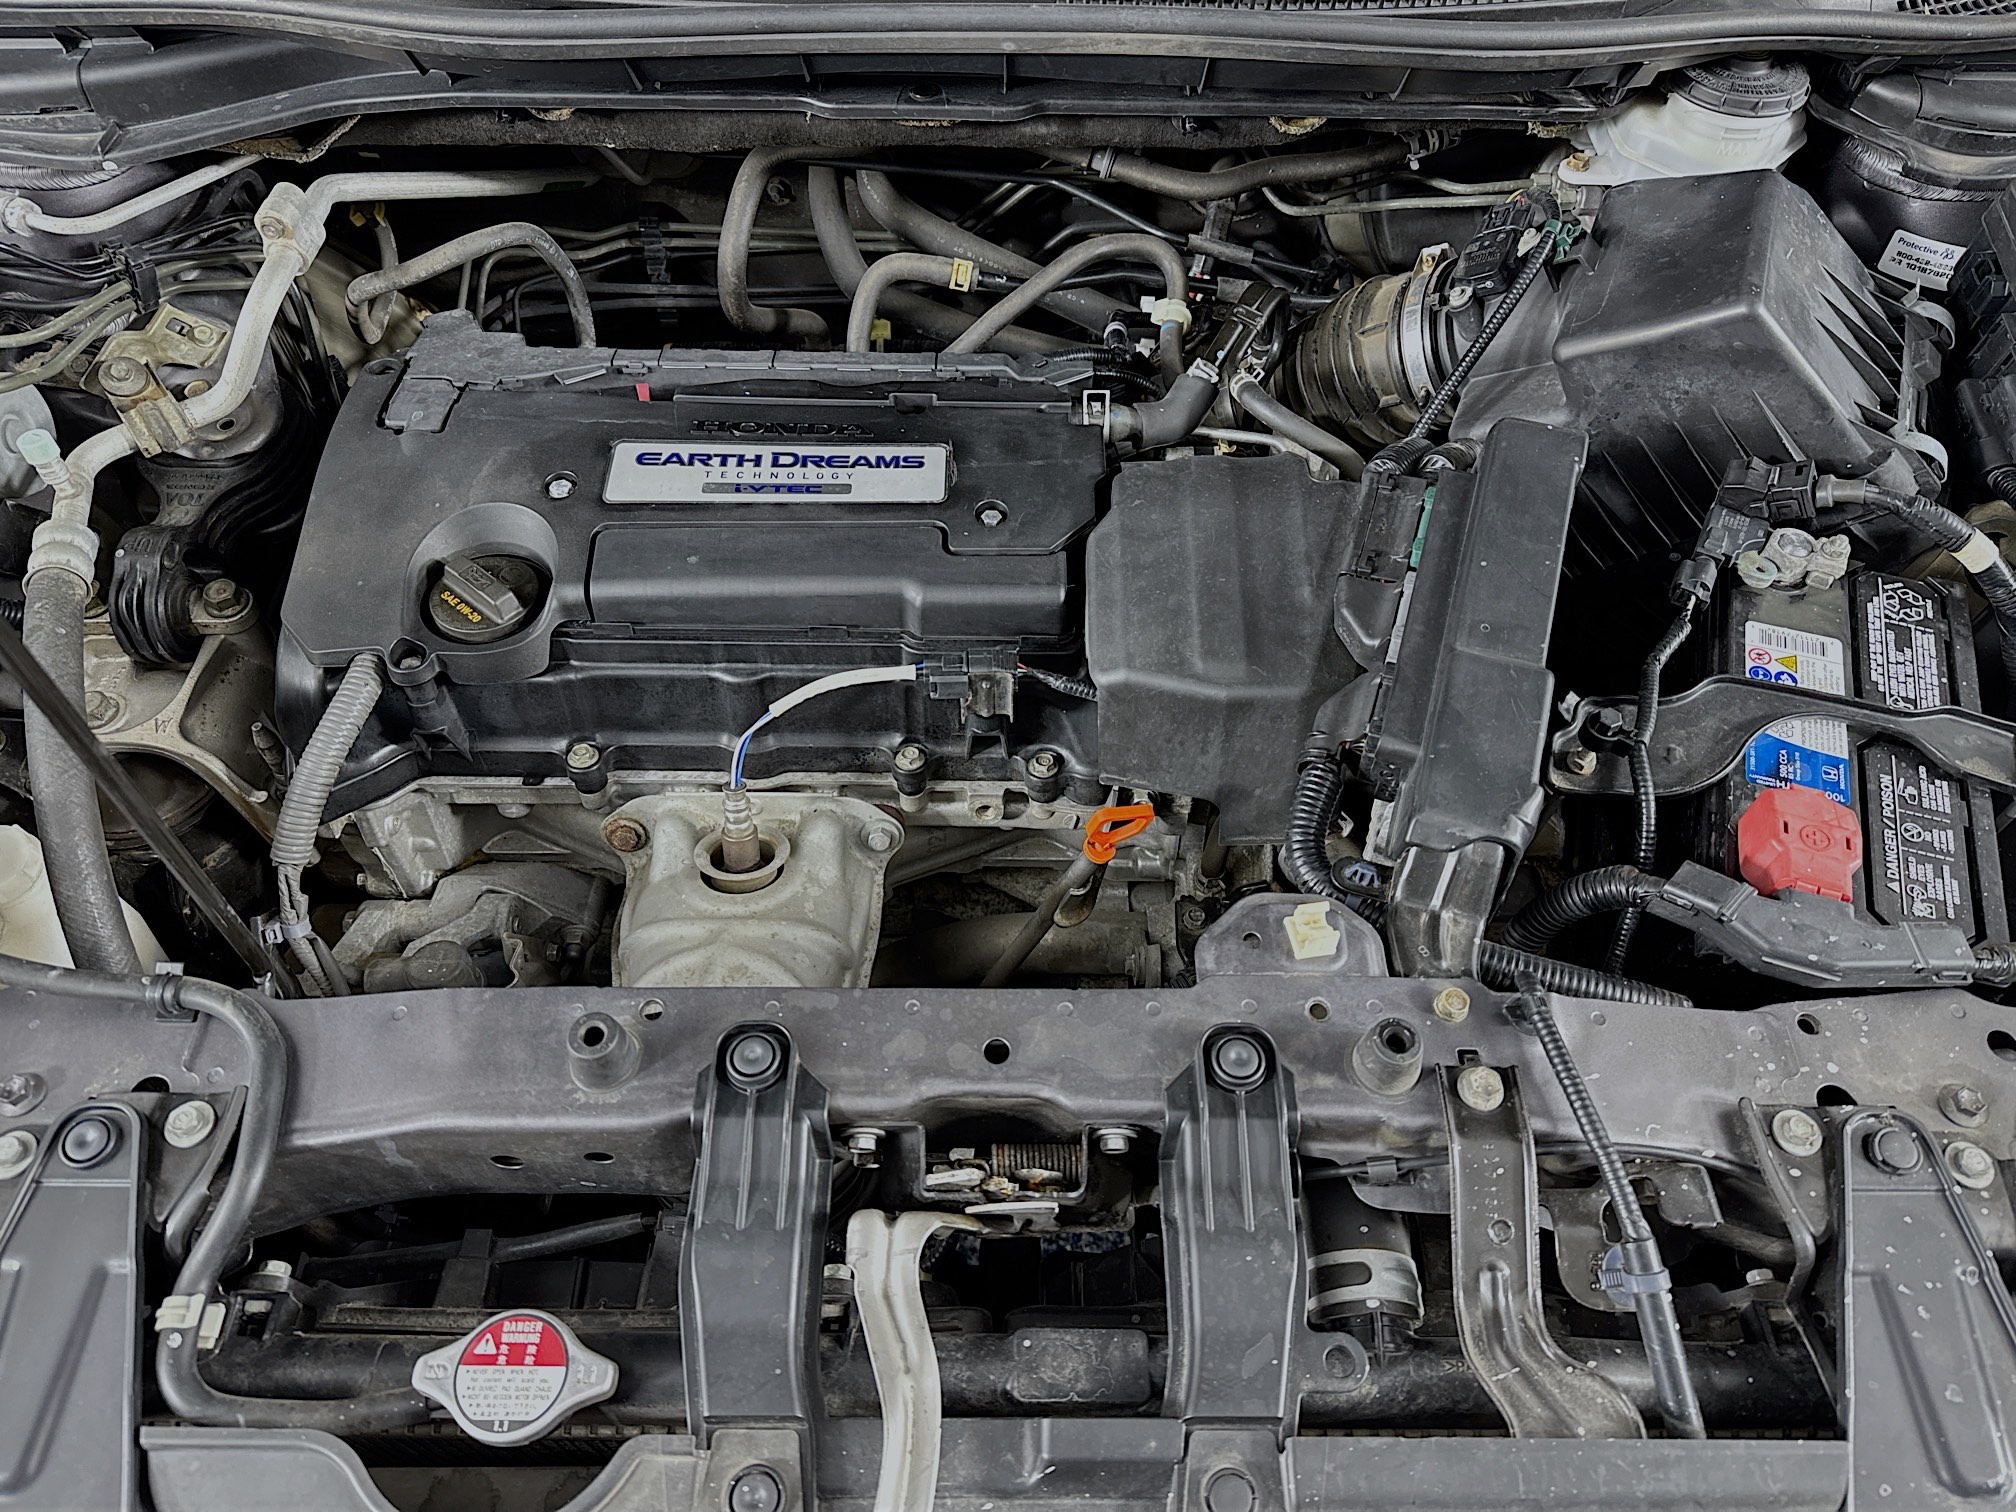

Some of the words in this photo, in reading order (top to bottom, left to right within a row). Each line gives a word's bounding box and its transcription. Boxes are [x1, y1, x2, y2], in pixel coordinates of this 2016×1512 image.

[1897, 236, 1939, 256] Protective
[690, 419, 874, 437] HONDA
[635, 452, 762, 468] EARTH
[770, 451, 926, 469] DREAMS
[704, 471, 854, 480] TECHNOLOGY
[734, 483, 823, 494] i-VTEC
[441, 591, 460, 606] SAE
[456, 603, 482, 623] 0W-20
[1779, 749, 1787, 764] CCA
[1779, 764, 1788, 778] 500
[1838, 763, 1846, 790] HONDA
[1825, 791, 1846, 803] 100
[1879, 773, 1895, 818] POISON
[1883, 828, 1900, 879] DANGER
[1908, 857, 1917, 880] SHIELD
[1917, 864, 1925, 881] EYES
[503, 1321, 543, 1333] DANGER
[492, 1420, 510, 1432] 1.1
